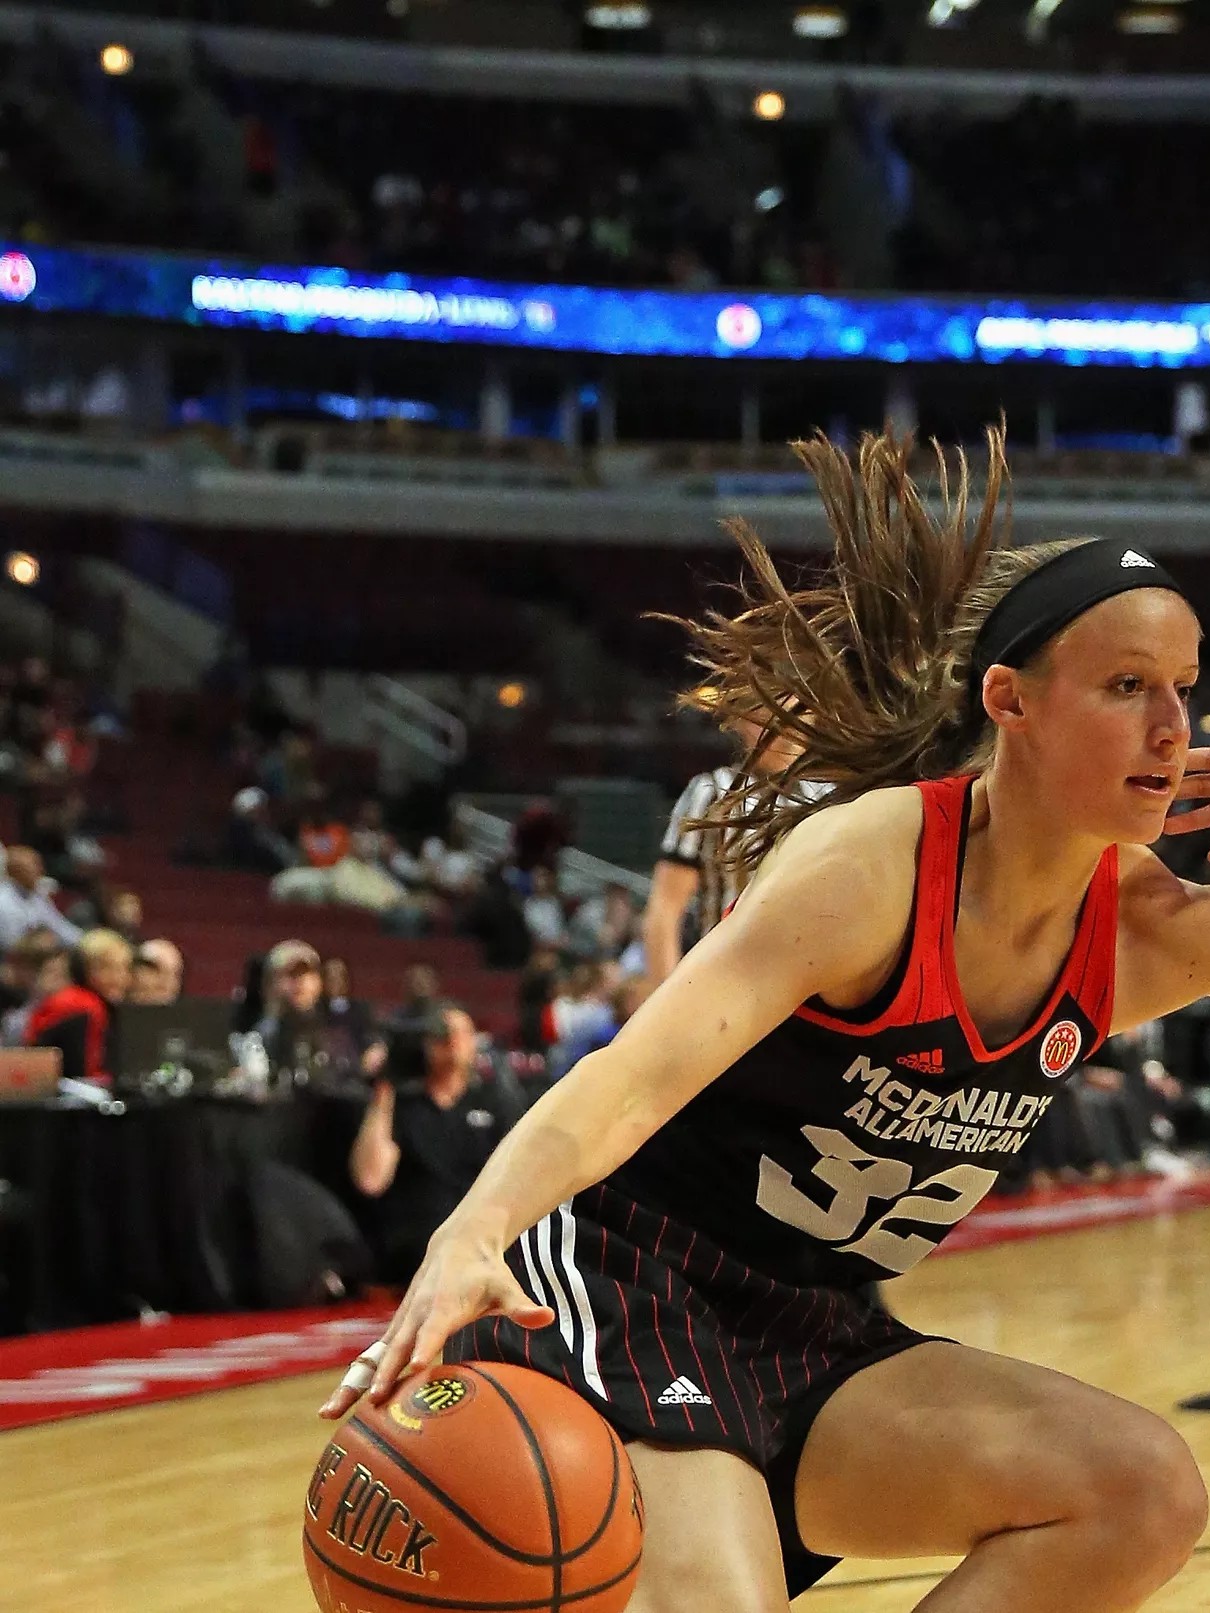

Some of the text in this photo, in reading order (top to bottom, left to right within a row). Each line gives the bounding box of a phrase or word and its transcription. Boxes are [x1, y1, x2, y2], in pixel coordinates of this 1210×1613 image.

[896, 1055, 945, 1075] adidas
[894, 1118, 1030, 1154] AMERICAN
[756, 1124, 999, 1273] 32
[657, 1392, 713, 1405] adidas
[326, 1462, 439, 1578] ROCK
